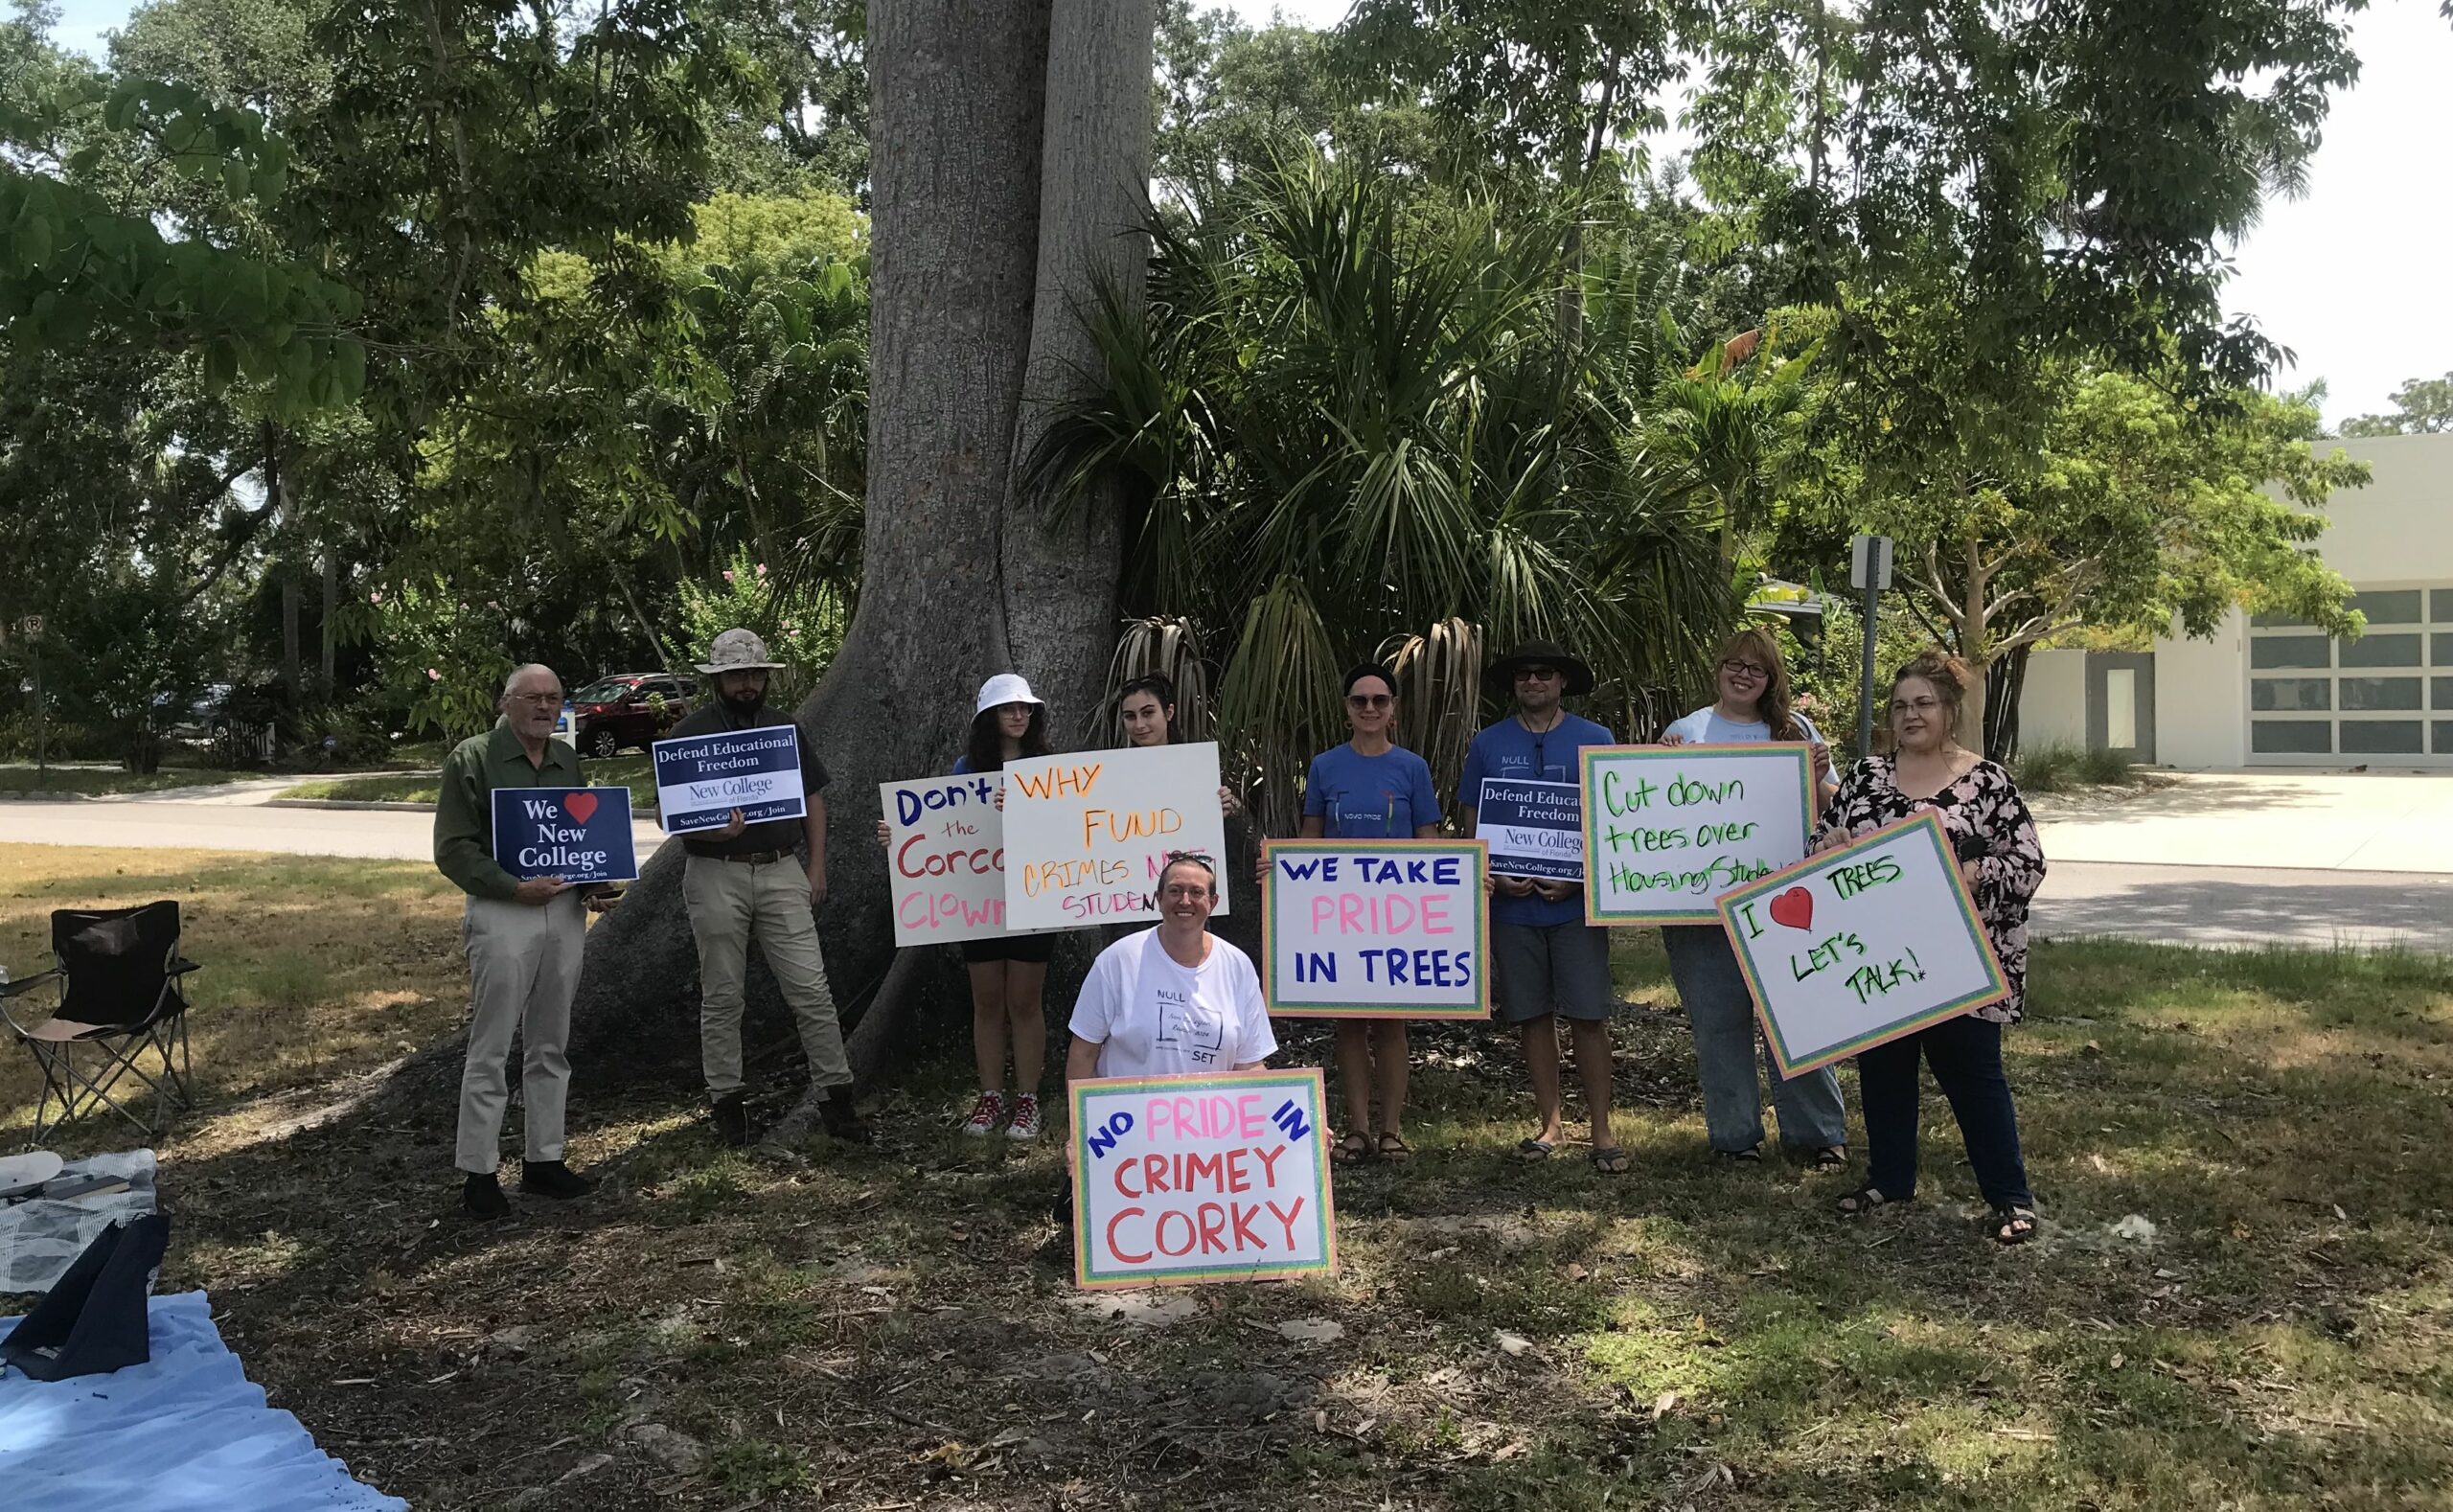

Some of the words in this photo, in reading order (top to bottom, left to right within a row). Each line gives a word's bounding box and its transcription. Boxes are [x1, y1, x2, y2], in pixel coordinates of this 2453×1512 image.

[658, 745, 709, 764] Defend
[713, 734, 793, 756] Educational
[1502, 756, 1529, 765] NULL
[698, 756, 759, 773] Freedom
[689, 785, 721, 801] New
[722, 777, 773, 797] College
[1014, 764, 1103, 800] WHY
[1603, 770, 1659, 818] Cut
[1667, 772, 1744, 807] down
[522, 800, 559, 820] We
[737, 793, 759, 803] Florida
[896, 777, 993, 827] Don't
[1484, 788, 1533, 803] Defend
[1536, 791, 1581, 807] Educa
[941, 820, 979, 837] the
[1085, 808, 1182, 849] FUND
[1518, 806, 1580, 822] Freedom
[538, 824, 587, 843] New
[1504, 828, 1536, 846] New
[1604, 824, 1689, 854] trees
[1696, 821, 1759, 848] over
[518, 846, 608, 872] College
[1549, 850, 1571, 859] Florida
[1023, 859, 1131, 899] CRIMES
[1279, 857, 1339, 882] WE
[1353, 858, 1460, 885] TAKE
[1609, 860, 1710, 896] Housing
[1741, 903, 1765, 939] I
[1824, 855, 1904, 901] TREES
[1311, 892, 1455, 935] PRIDE
[1295, 951, 1338, 983] IN
[1359, 948, 1471, 987] TREES
[1790, 932, 1868, 983] LET'S
[1844, 947, 1927, 1005] TALK!
[1158, 989, 1185, 1002] NULL
[1191, 1050, 1217, 1065] SET
[1088, 1111, 1134, 1158] NO
[1146, 1094, 1268, 1142] PRIDE
[1271, 1099, 1311, 1142] IN
[1113, 1143, 1287, 1199] CRIMEY
[1106, 1195, 1305, 1264] CORKY
